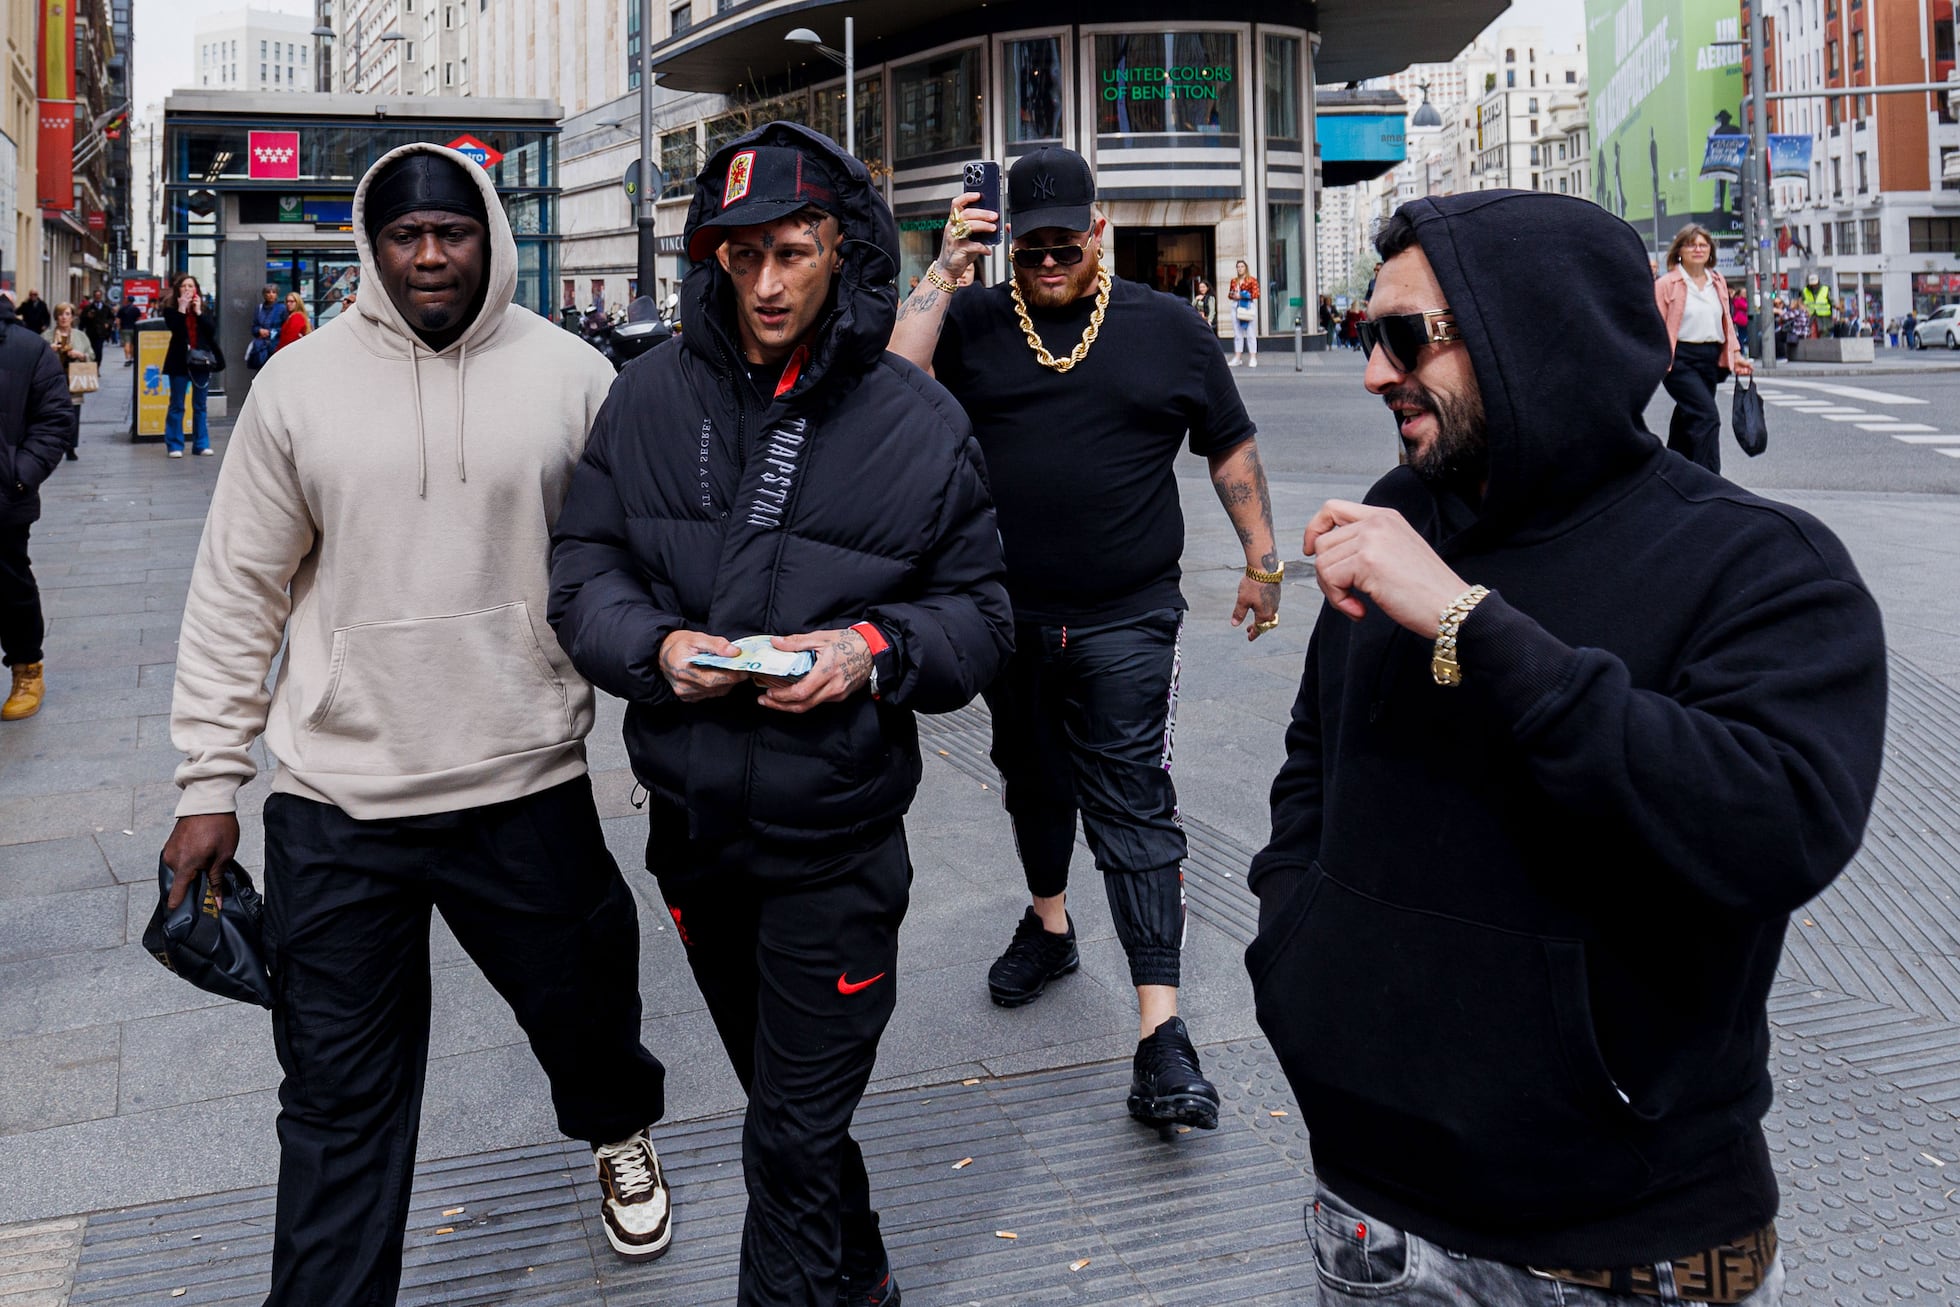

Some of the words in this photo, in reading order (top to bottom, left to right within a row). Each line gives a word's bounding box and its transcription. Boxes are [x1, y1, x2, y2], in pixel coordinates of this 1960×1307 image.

[1716, 16, 1738, 42] UN
[1103, 67, 1165, 82] UNITED
[1169, 66, 1232, 82] COLORS
[1103, 86, 1127, 100] OF
[1032, 173, 1056, 200] NY
[746, 417, 807, 528] TRAPSTAR
